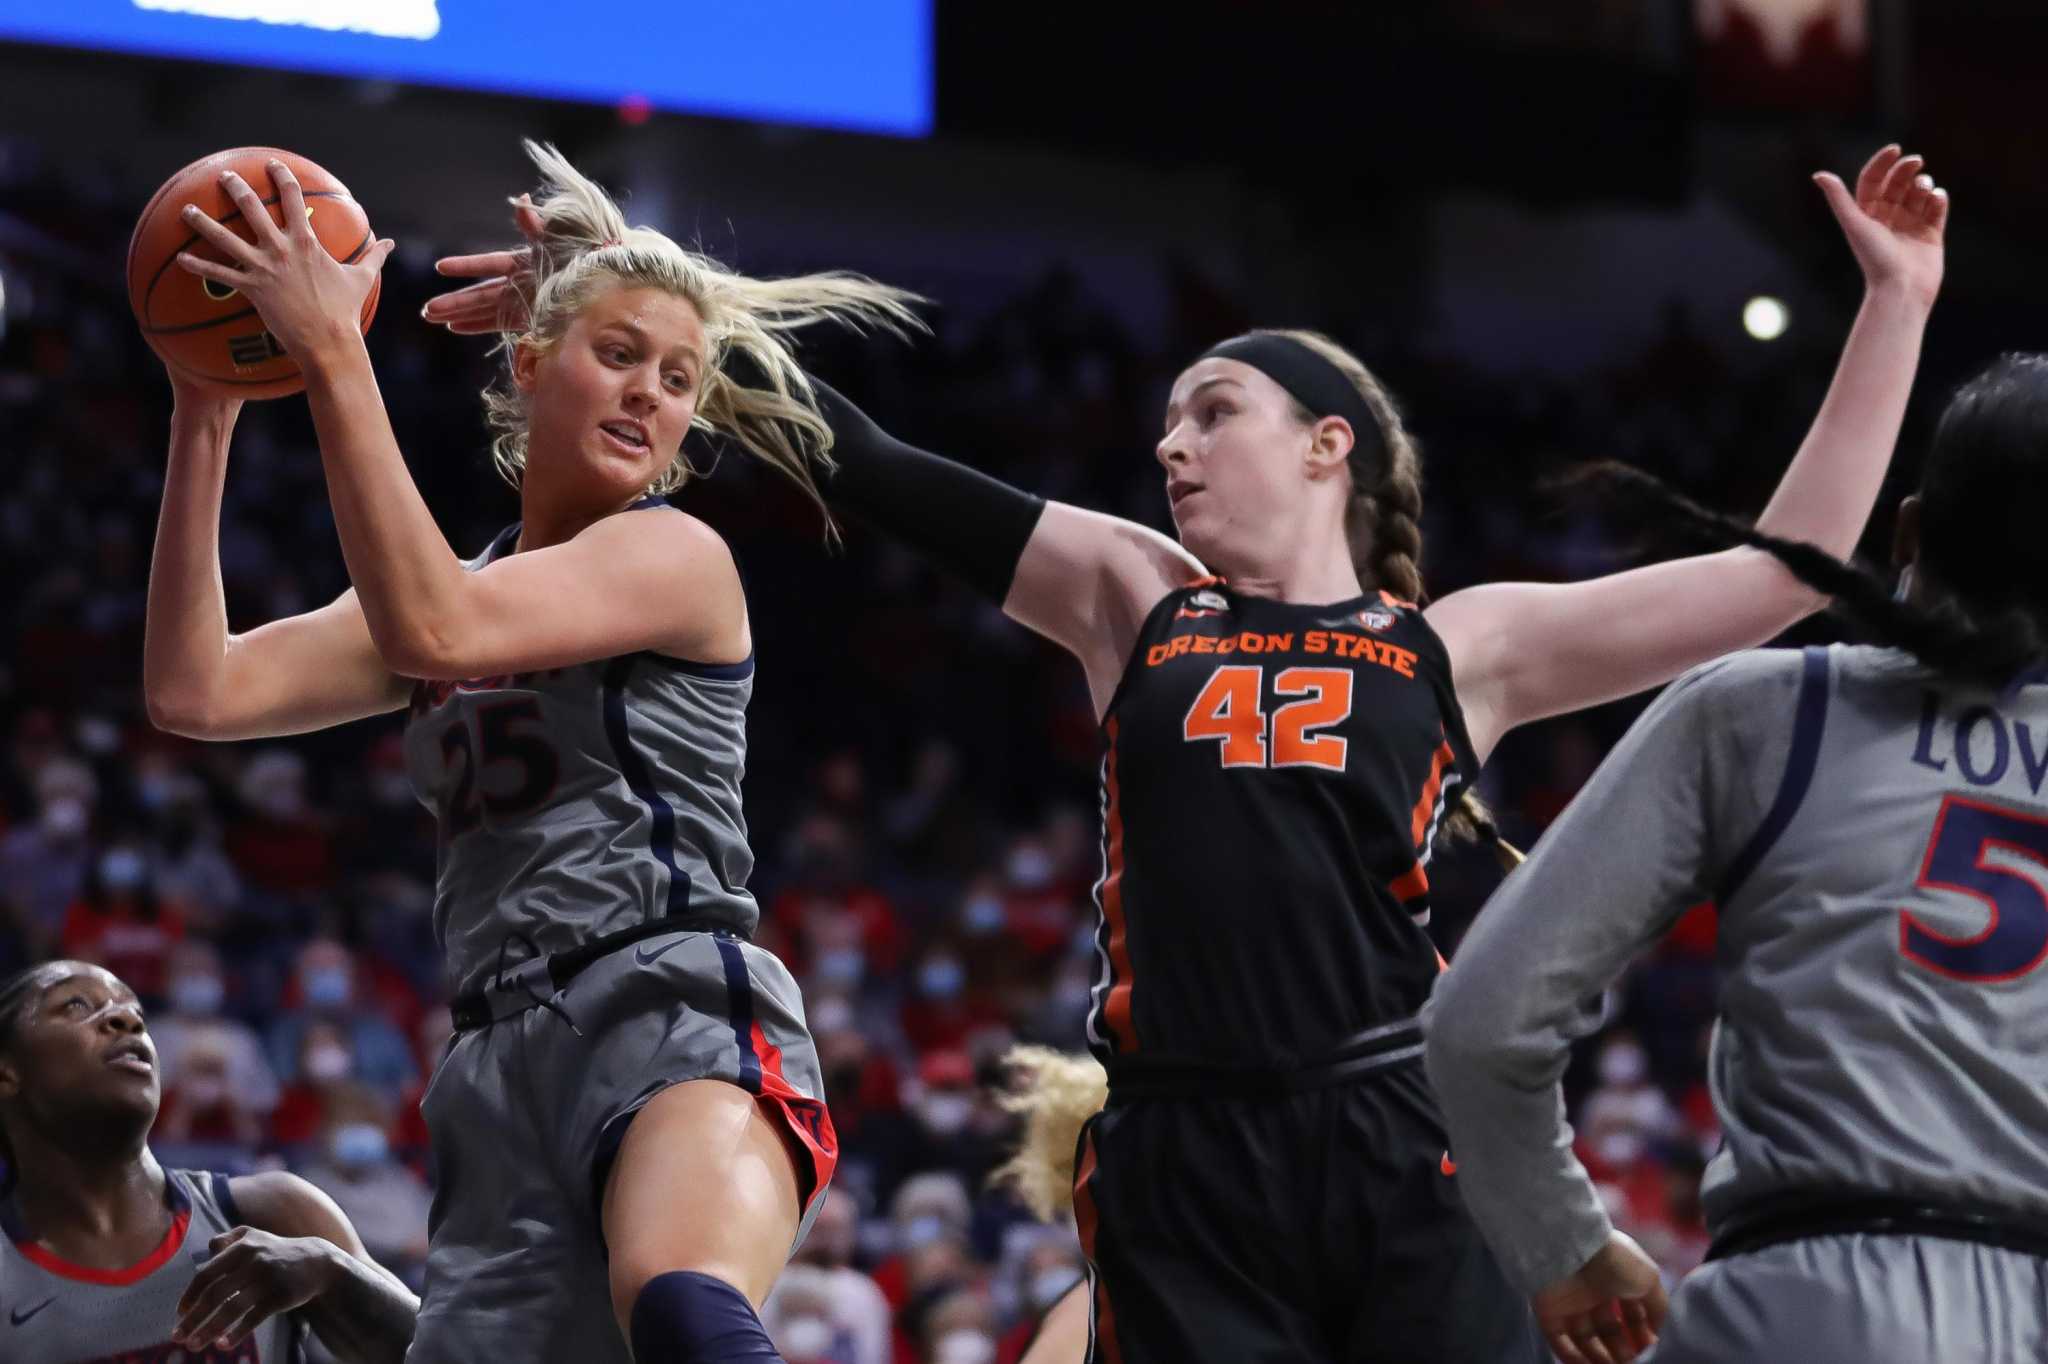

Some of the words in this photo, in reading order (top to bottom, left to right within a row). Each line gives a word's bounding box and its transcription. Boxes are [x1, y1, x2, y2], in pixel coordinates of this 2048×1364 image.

[1147, 632, 1294, 666] OREGON
[1304, 632, 1418, 678] STATE
[1183, 665, 1354, 773] 42
[1900, 793, 2048, 982] 5
